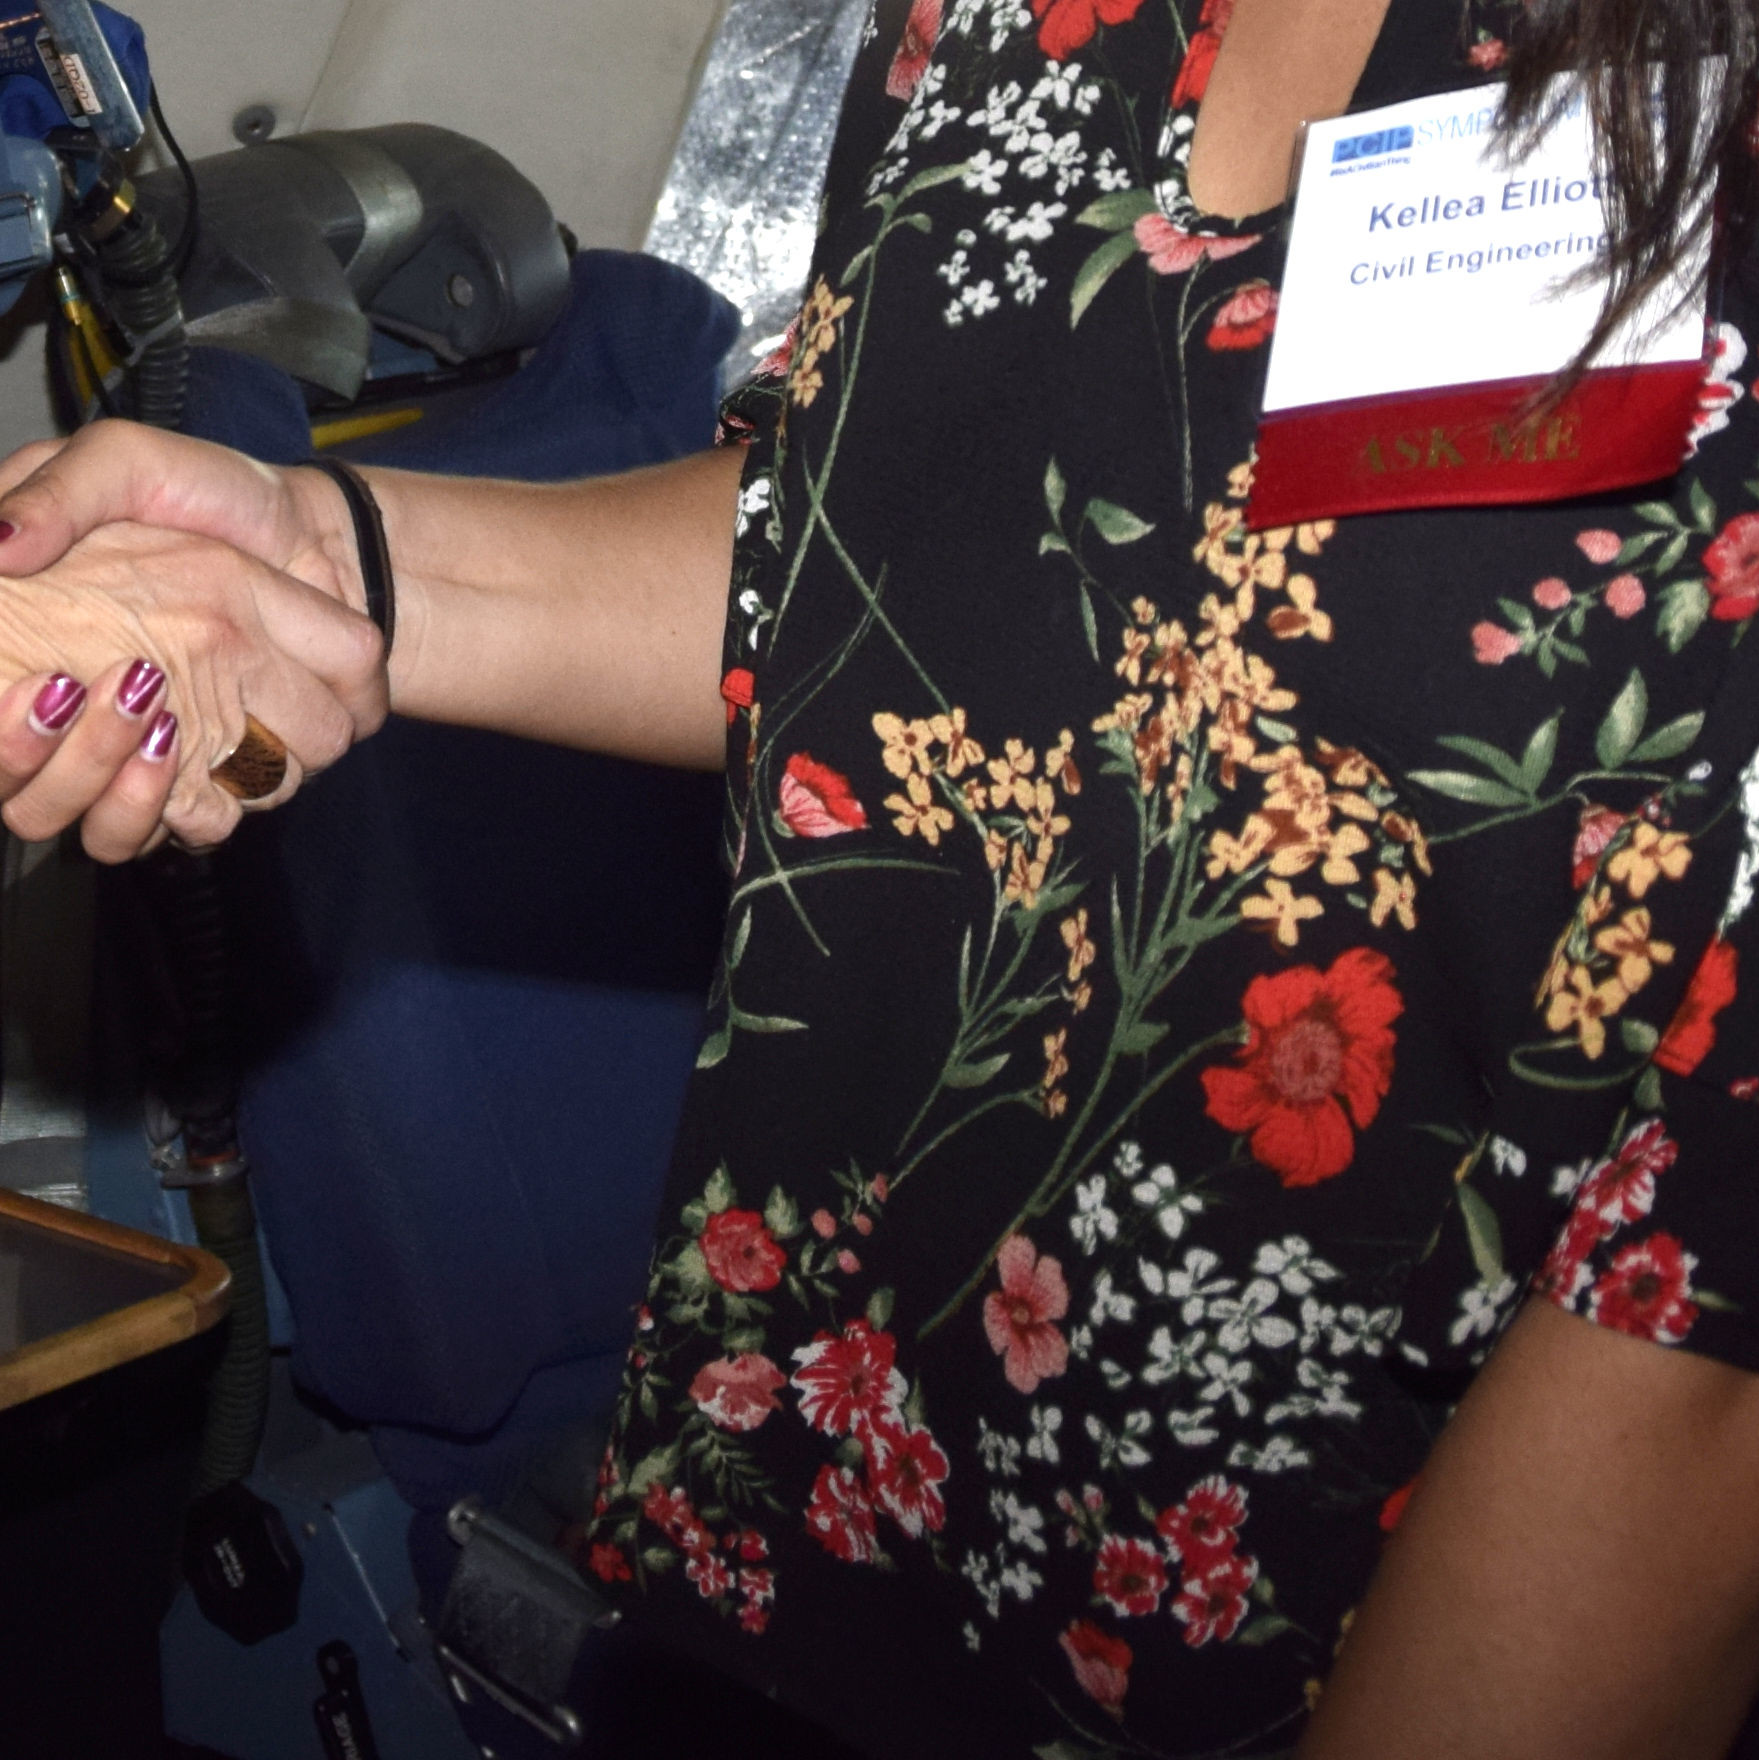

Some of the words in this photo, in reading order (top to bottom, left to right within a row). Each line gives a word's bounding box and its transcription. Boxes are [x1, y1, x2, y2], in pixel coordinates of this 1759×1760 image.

[1368, 194, 1486, 233] Kellea
[1349, 255, 1415, 286] Civil
[1425, 231, 1614, 274] Engineering
[1357, 427, 1466, 474] ASK
[1488, 413, 1582, 464] ME
